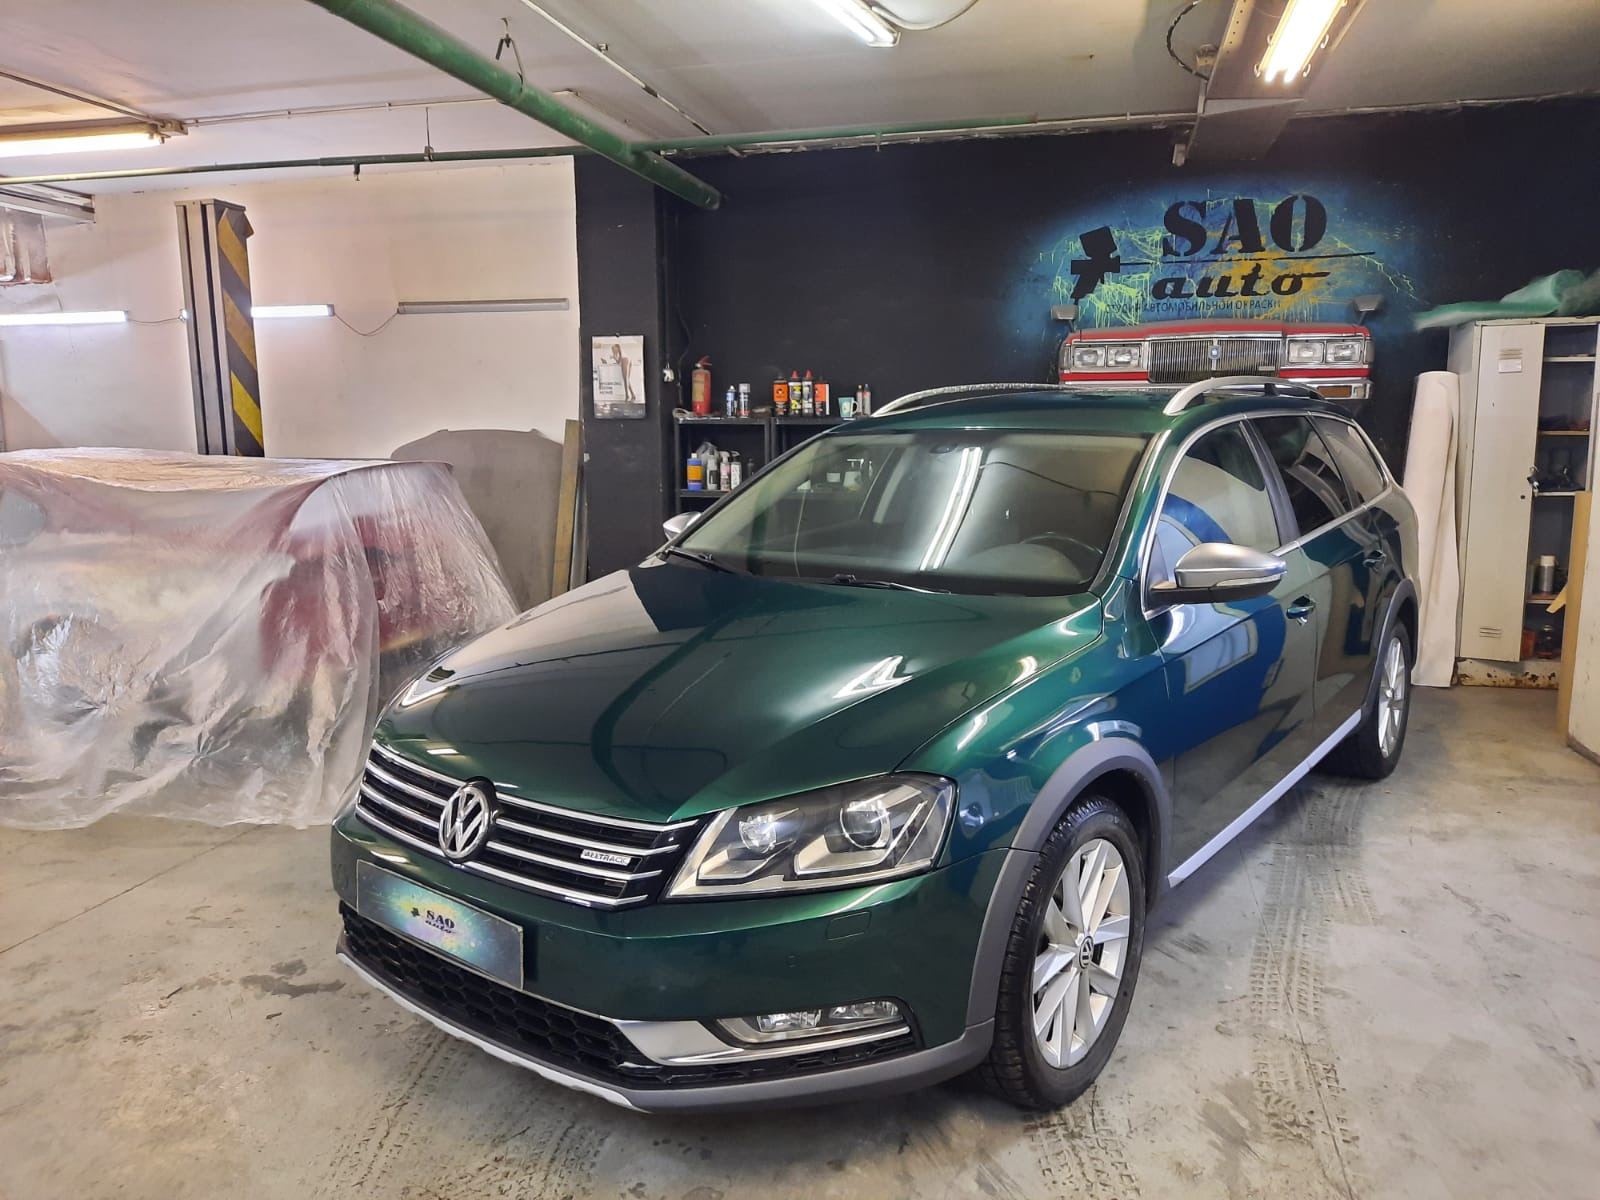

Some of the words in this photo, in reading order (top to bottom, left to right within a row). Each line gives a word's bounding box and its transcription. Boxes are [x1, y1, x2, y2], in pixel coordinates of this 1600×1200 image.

[1164, 195, 1327, 257] SAO
[1152, 263, 1330, 300] auto
[426, 910, 455, 928] SAO
